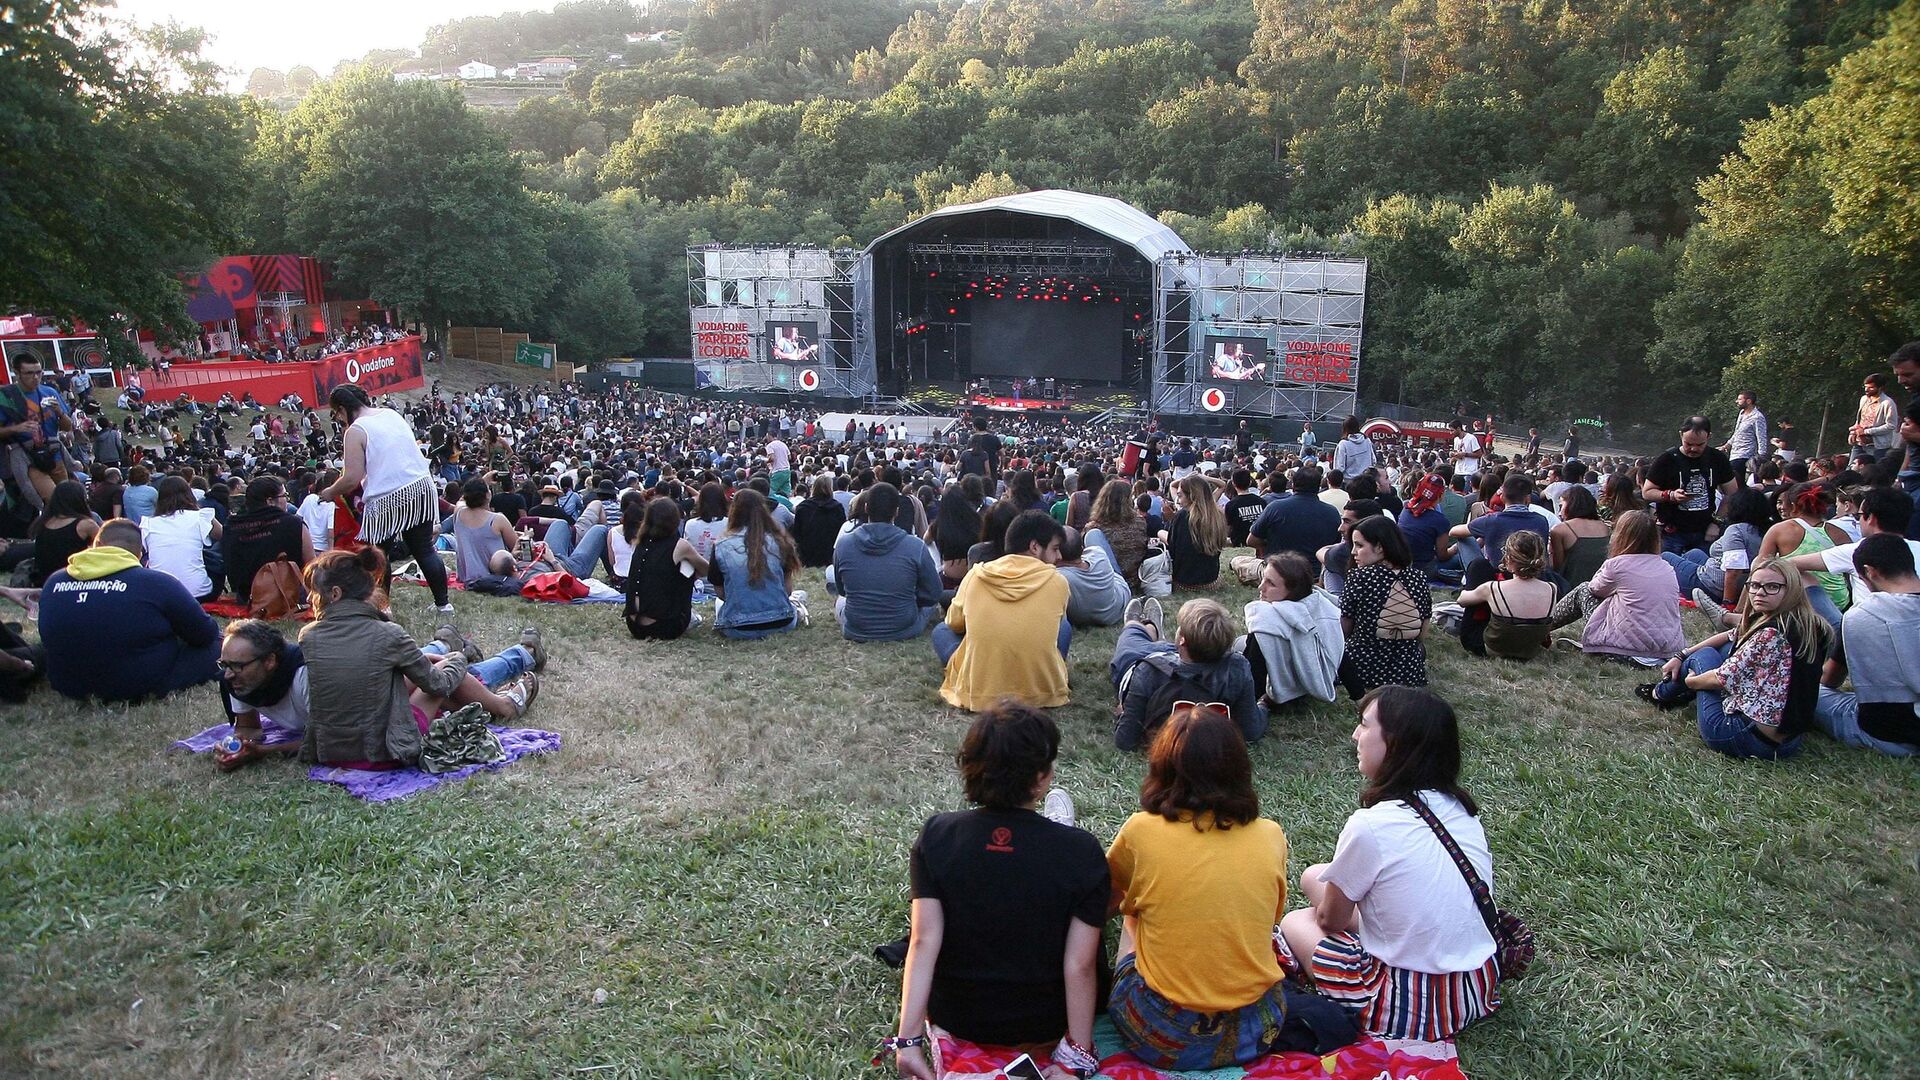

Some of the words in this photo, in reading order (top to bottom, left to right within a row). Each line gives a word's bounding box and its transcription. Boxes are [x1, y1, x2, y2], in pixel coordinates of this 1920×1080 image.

[698, 321, 748, 331] VODAFONE
[698, 332, 749, 345] PAREDES
[704, 345, 749, 359] COURA
[1287, 341, 1351, 353] VODAFONE
[361, 356, 395, 373] vodafone
[1286, 353, 1351, 368] PAREDES
[1422, 421, 1446, 429] SUPER
[1573, 418, 1605, 428] JAMESON
[1372, 432, 1398, 440] BOCK
[53, 580, 127, 594] PROGRAMAÇÃO
[77, 592, 88, 603] SI
